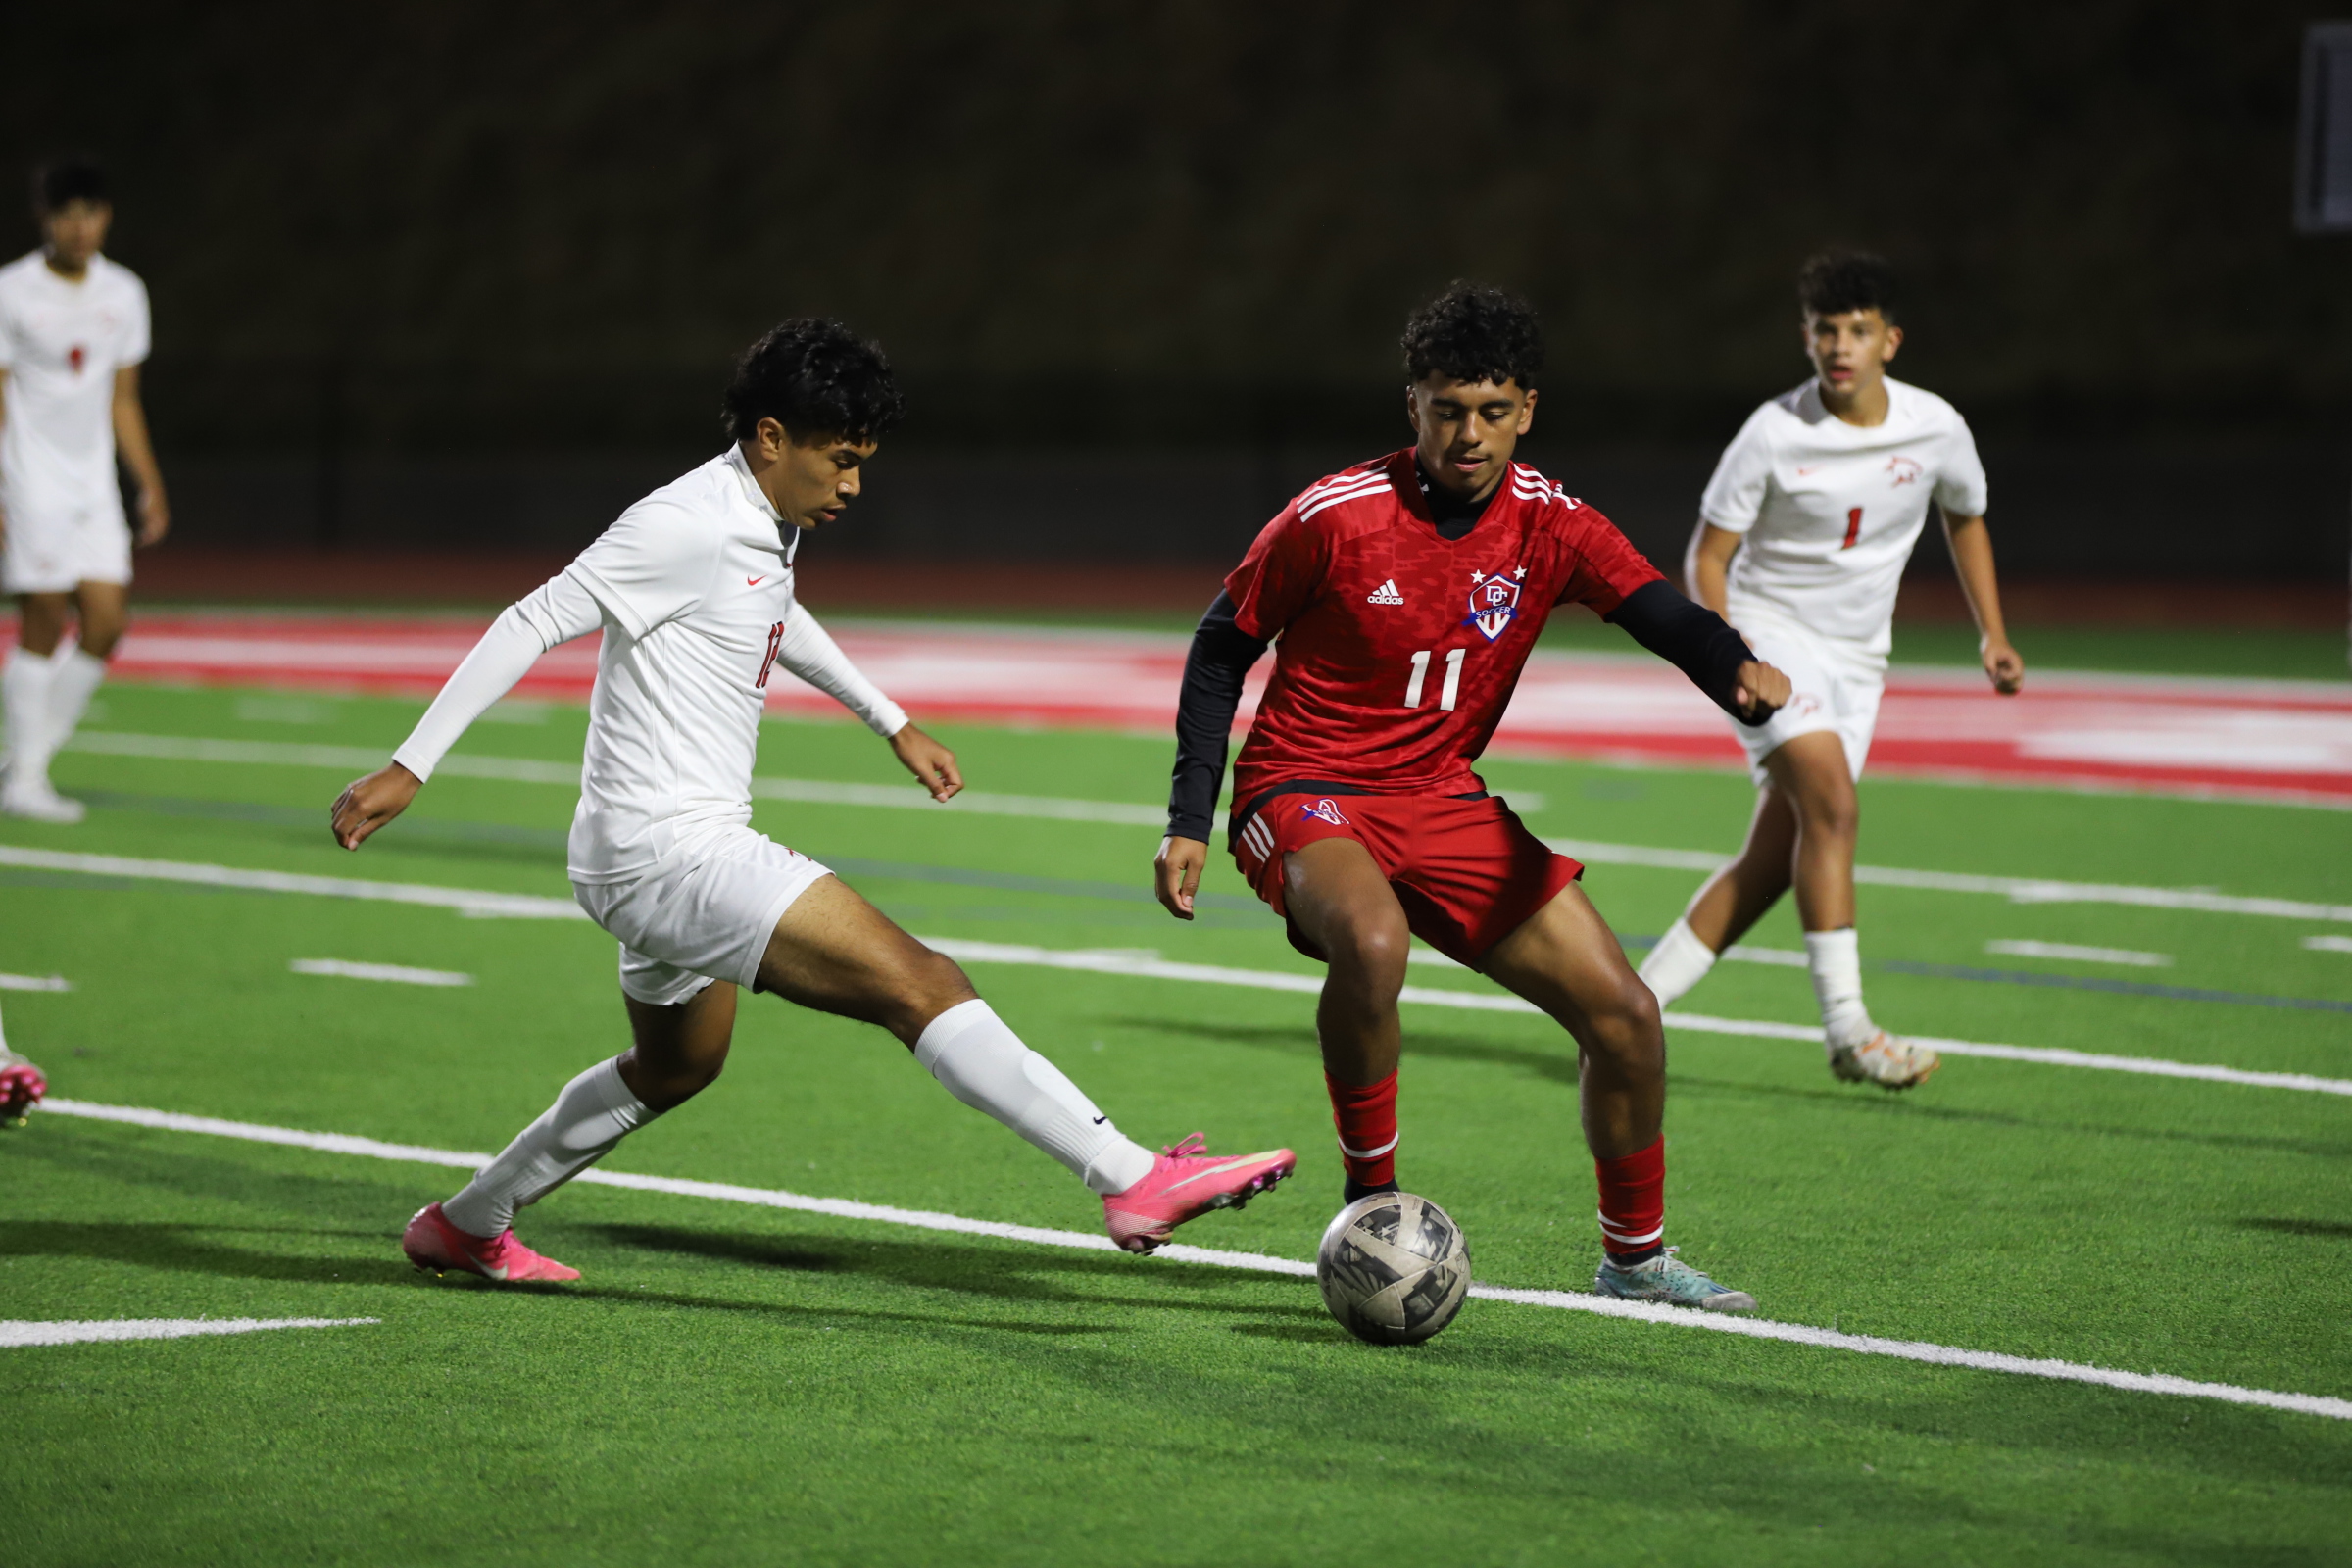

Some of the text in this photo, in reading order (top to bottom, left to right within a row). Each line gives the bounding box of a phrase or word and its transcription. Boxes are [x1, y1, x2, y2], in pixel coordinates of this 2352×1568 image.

[1840, 506, 1864, 551] 1
[1367, 594, 1404, 605] adidas
[1486, 585, 1507, 607] DC
[1475, 606, 1511, 619] SOCCER
[1404, 648, 1466, 711] 11
